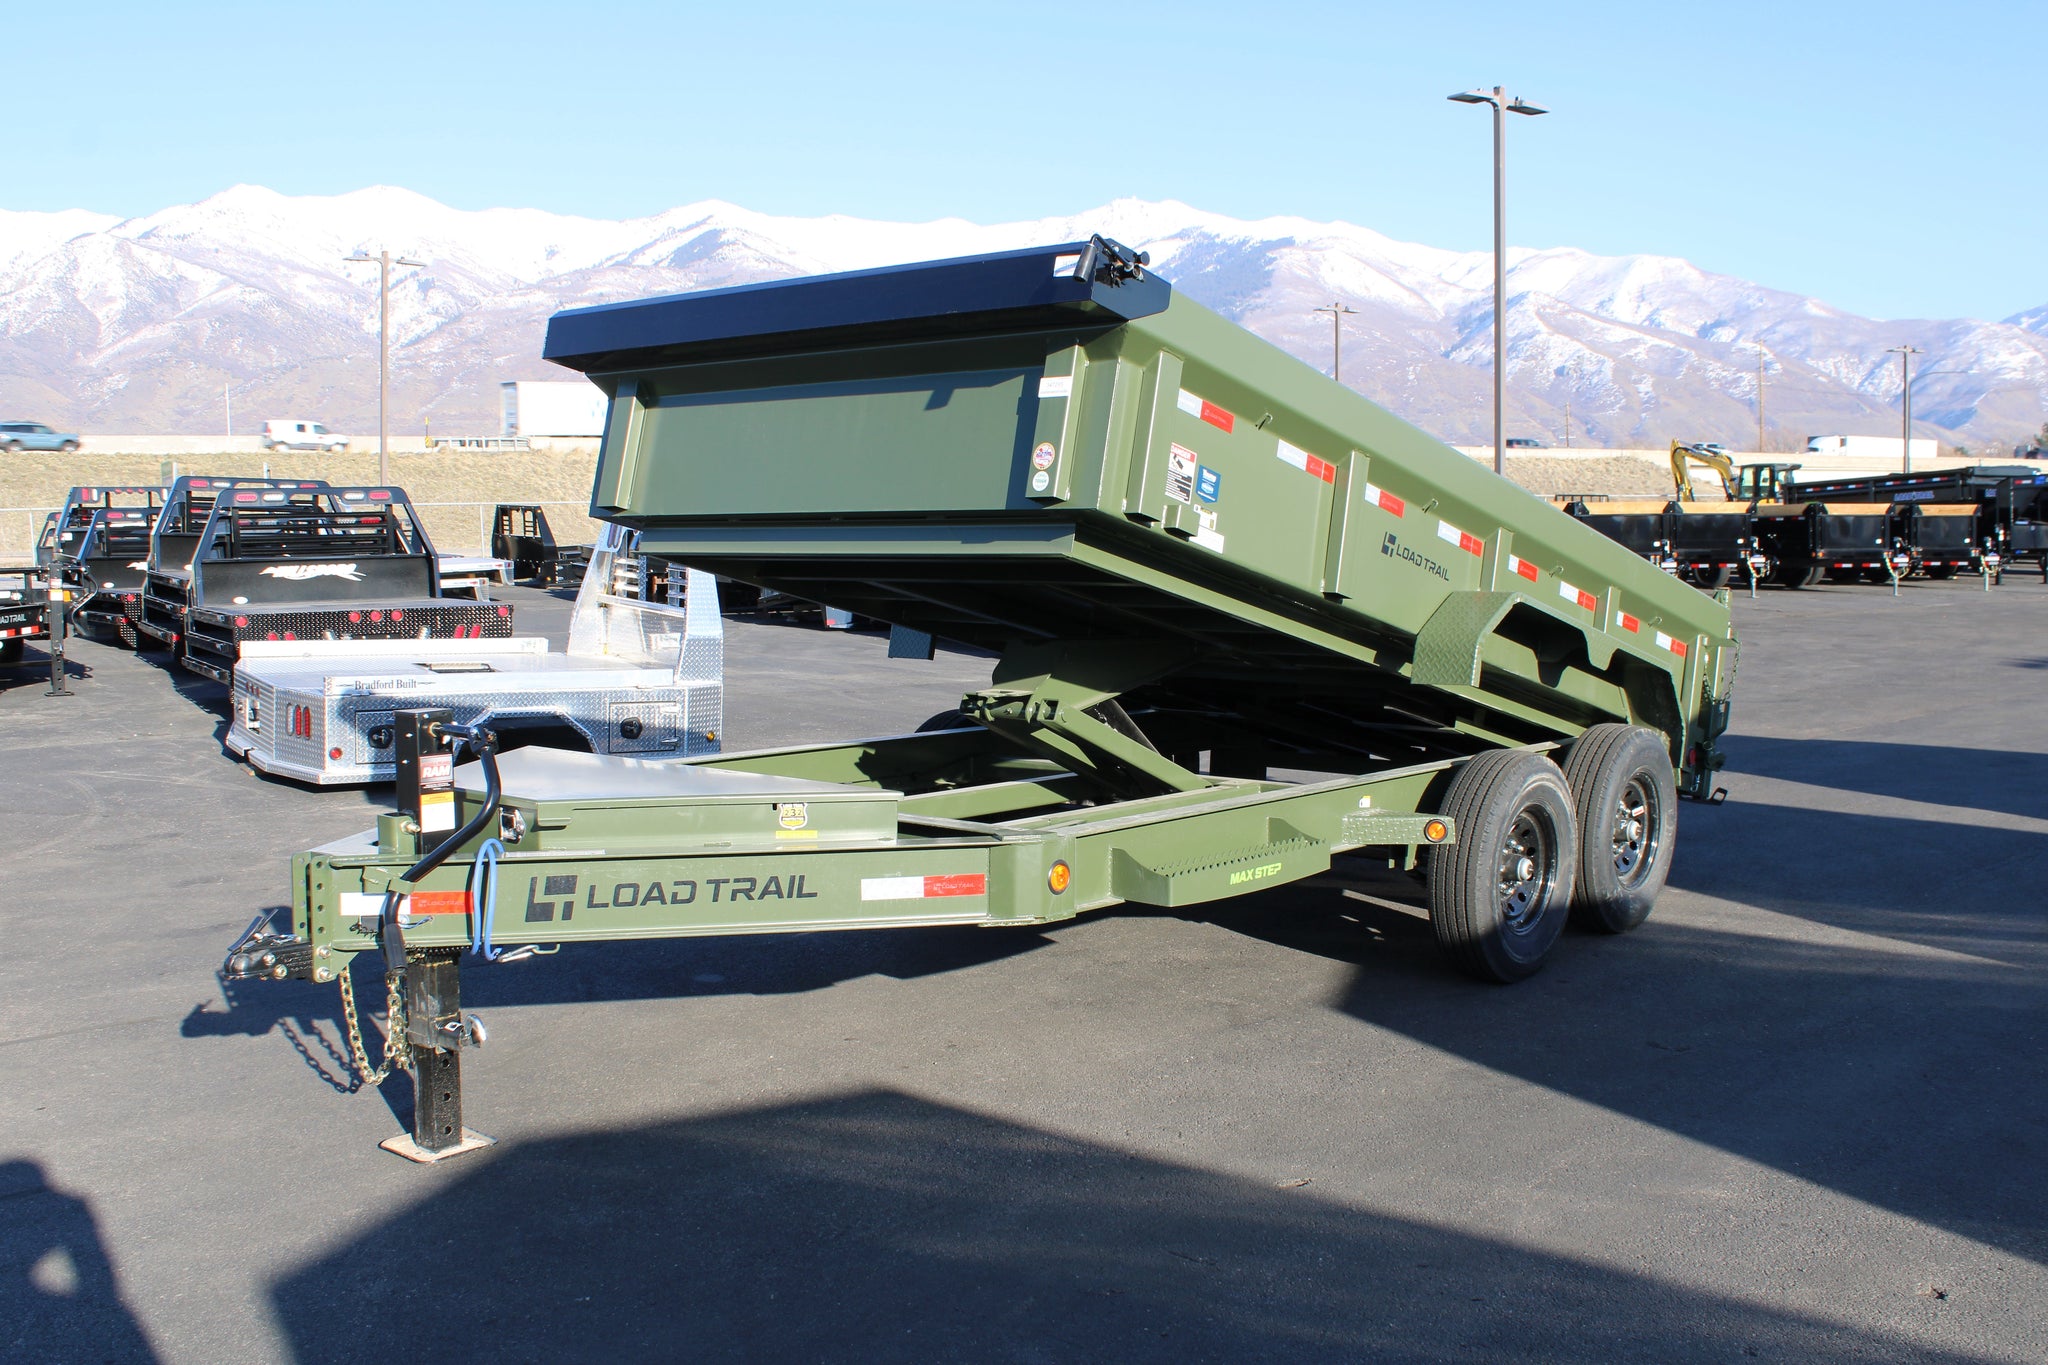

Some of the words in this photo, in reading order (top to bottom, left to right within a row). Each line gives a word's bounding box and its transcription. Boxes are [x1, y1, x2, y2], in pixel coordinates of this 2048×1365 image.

[1396, 543, 1422, 567] LOAD
[1424, 558, 1449, 581] TRAIL
[0, 615, 9, 624] AD
[9, 613, 27, 623] TRAIL
[354, 680, 394, 690] Bradford
[396, 679, 417, 689] Built
[422, 765, 450, 778] RAM
[1230, 868, 1254, 885] MAX
[1255, 862, 1282, 879] STEP
[587, 880, 697, 908] LOAD
[706, 875, 817, 902] TRAIL
